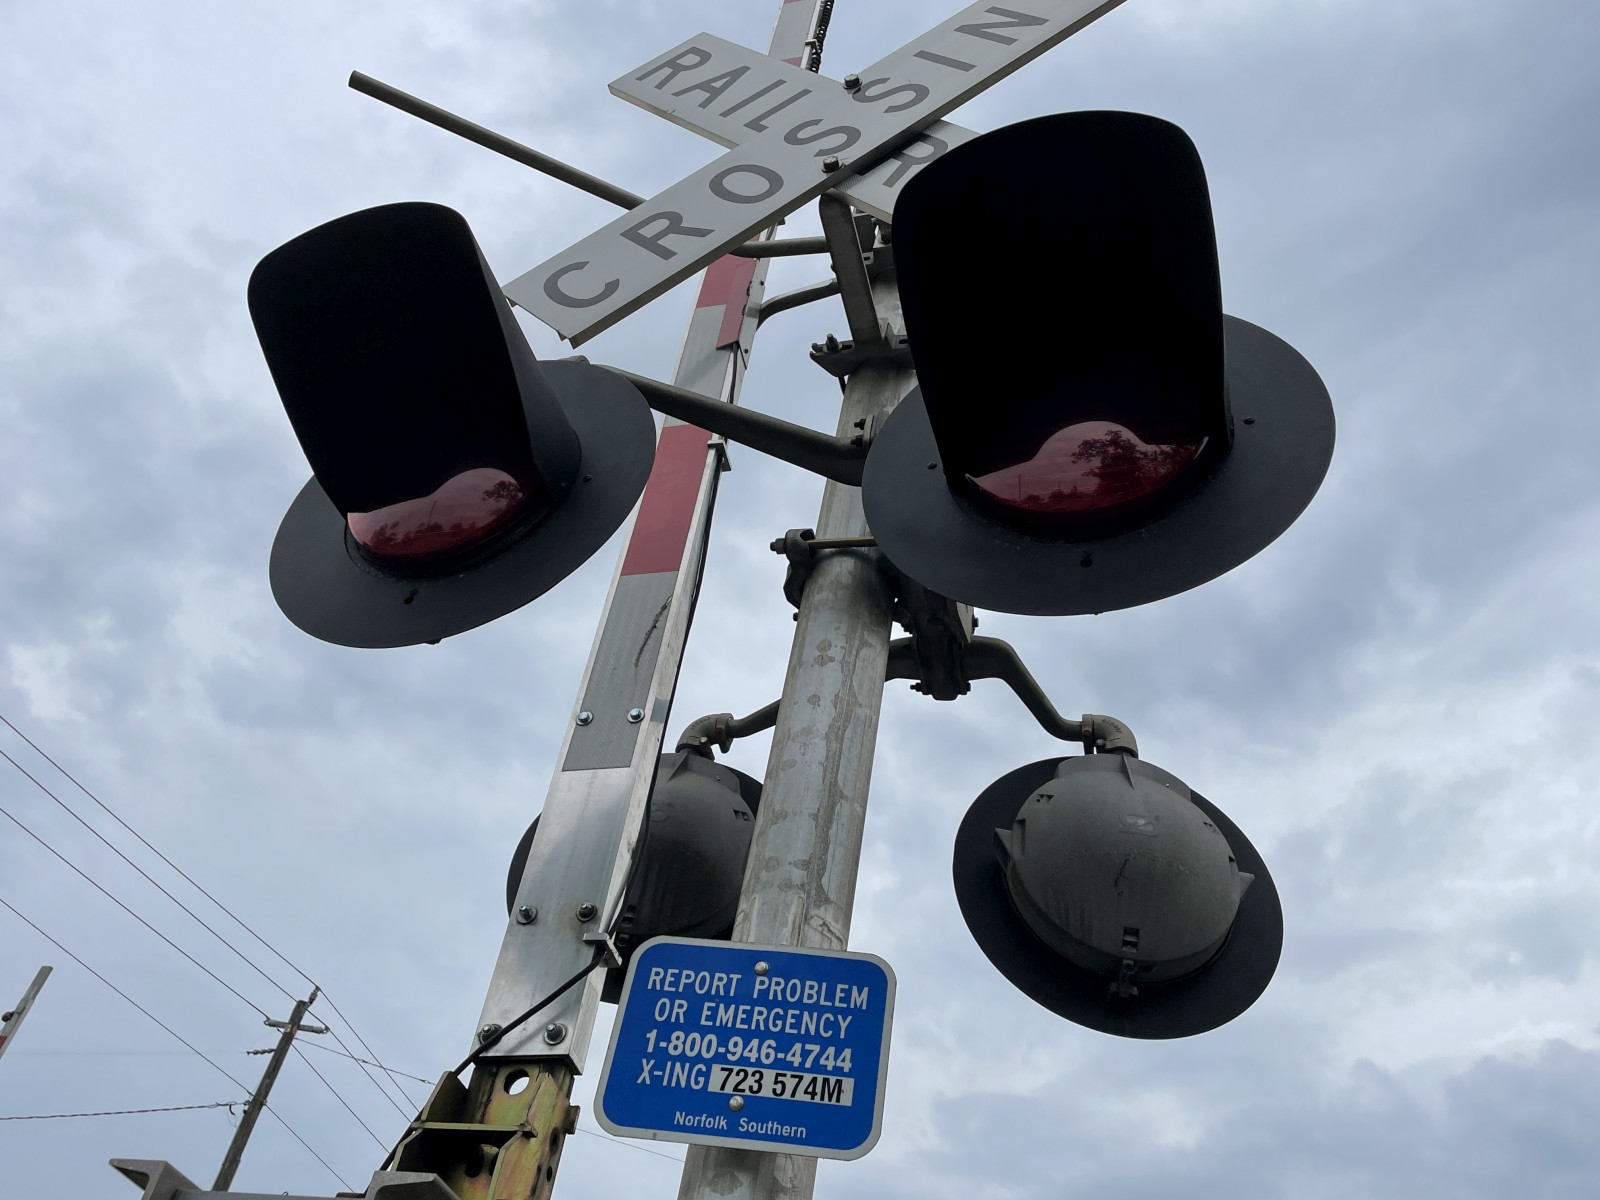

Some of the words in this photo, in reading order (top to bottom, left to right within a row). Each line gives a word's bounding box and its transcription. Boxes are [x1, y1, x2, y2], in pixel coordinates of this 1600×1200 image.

[635, 46, 813, 133] RAIL
[543, 6, 1050, 309] CROSSIN
[647, 967, 742, 997] REPORT
[753, 976, 869, 1010] PROBLEM
[654, 998, 688, 1023] OR
[700, 1002, 852, 1039] EMERGENCY
[645, 1029, 853, 1073] 1-800-946-4744
[636, 1058, 707, 1090] X-ING
[719, 1067, 764, 1095] 723
[772, 1072, 844, 1104] 574M
[674, 1111, 728, 1130] Norfolk
[738, 1117, 807, 1138] Southern
